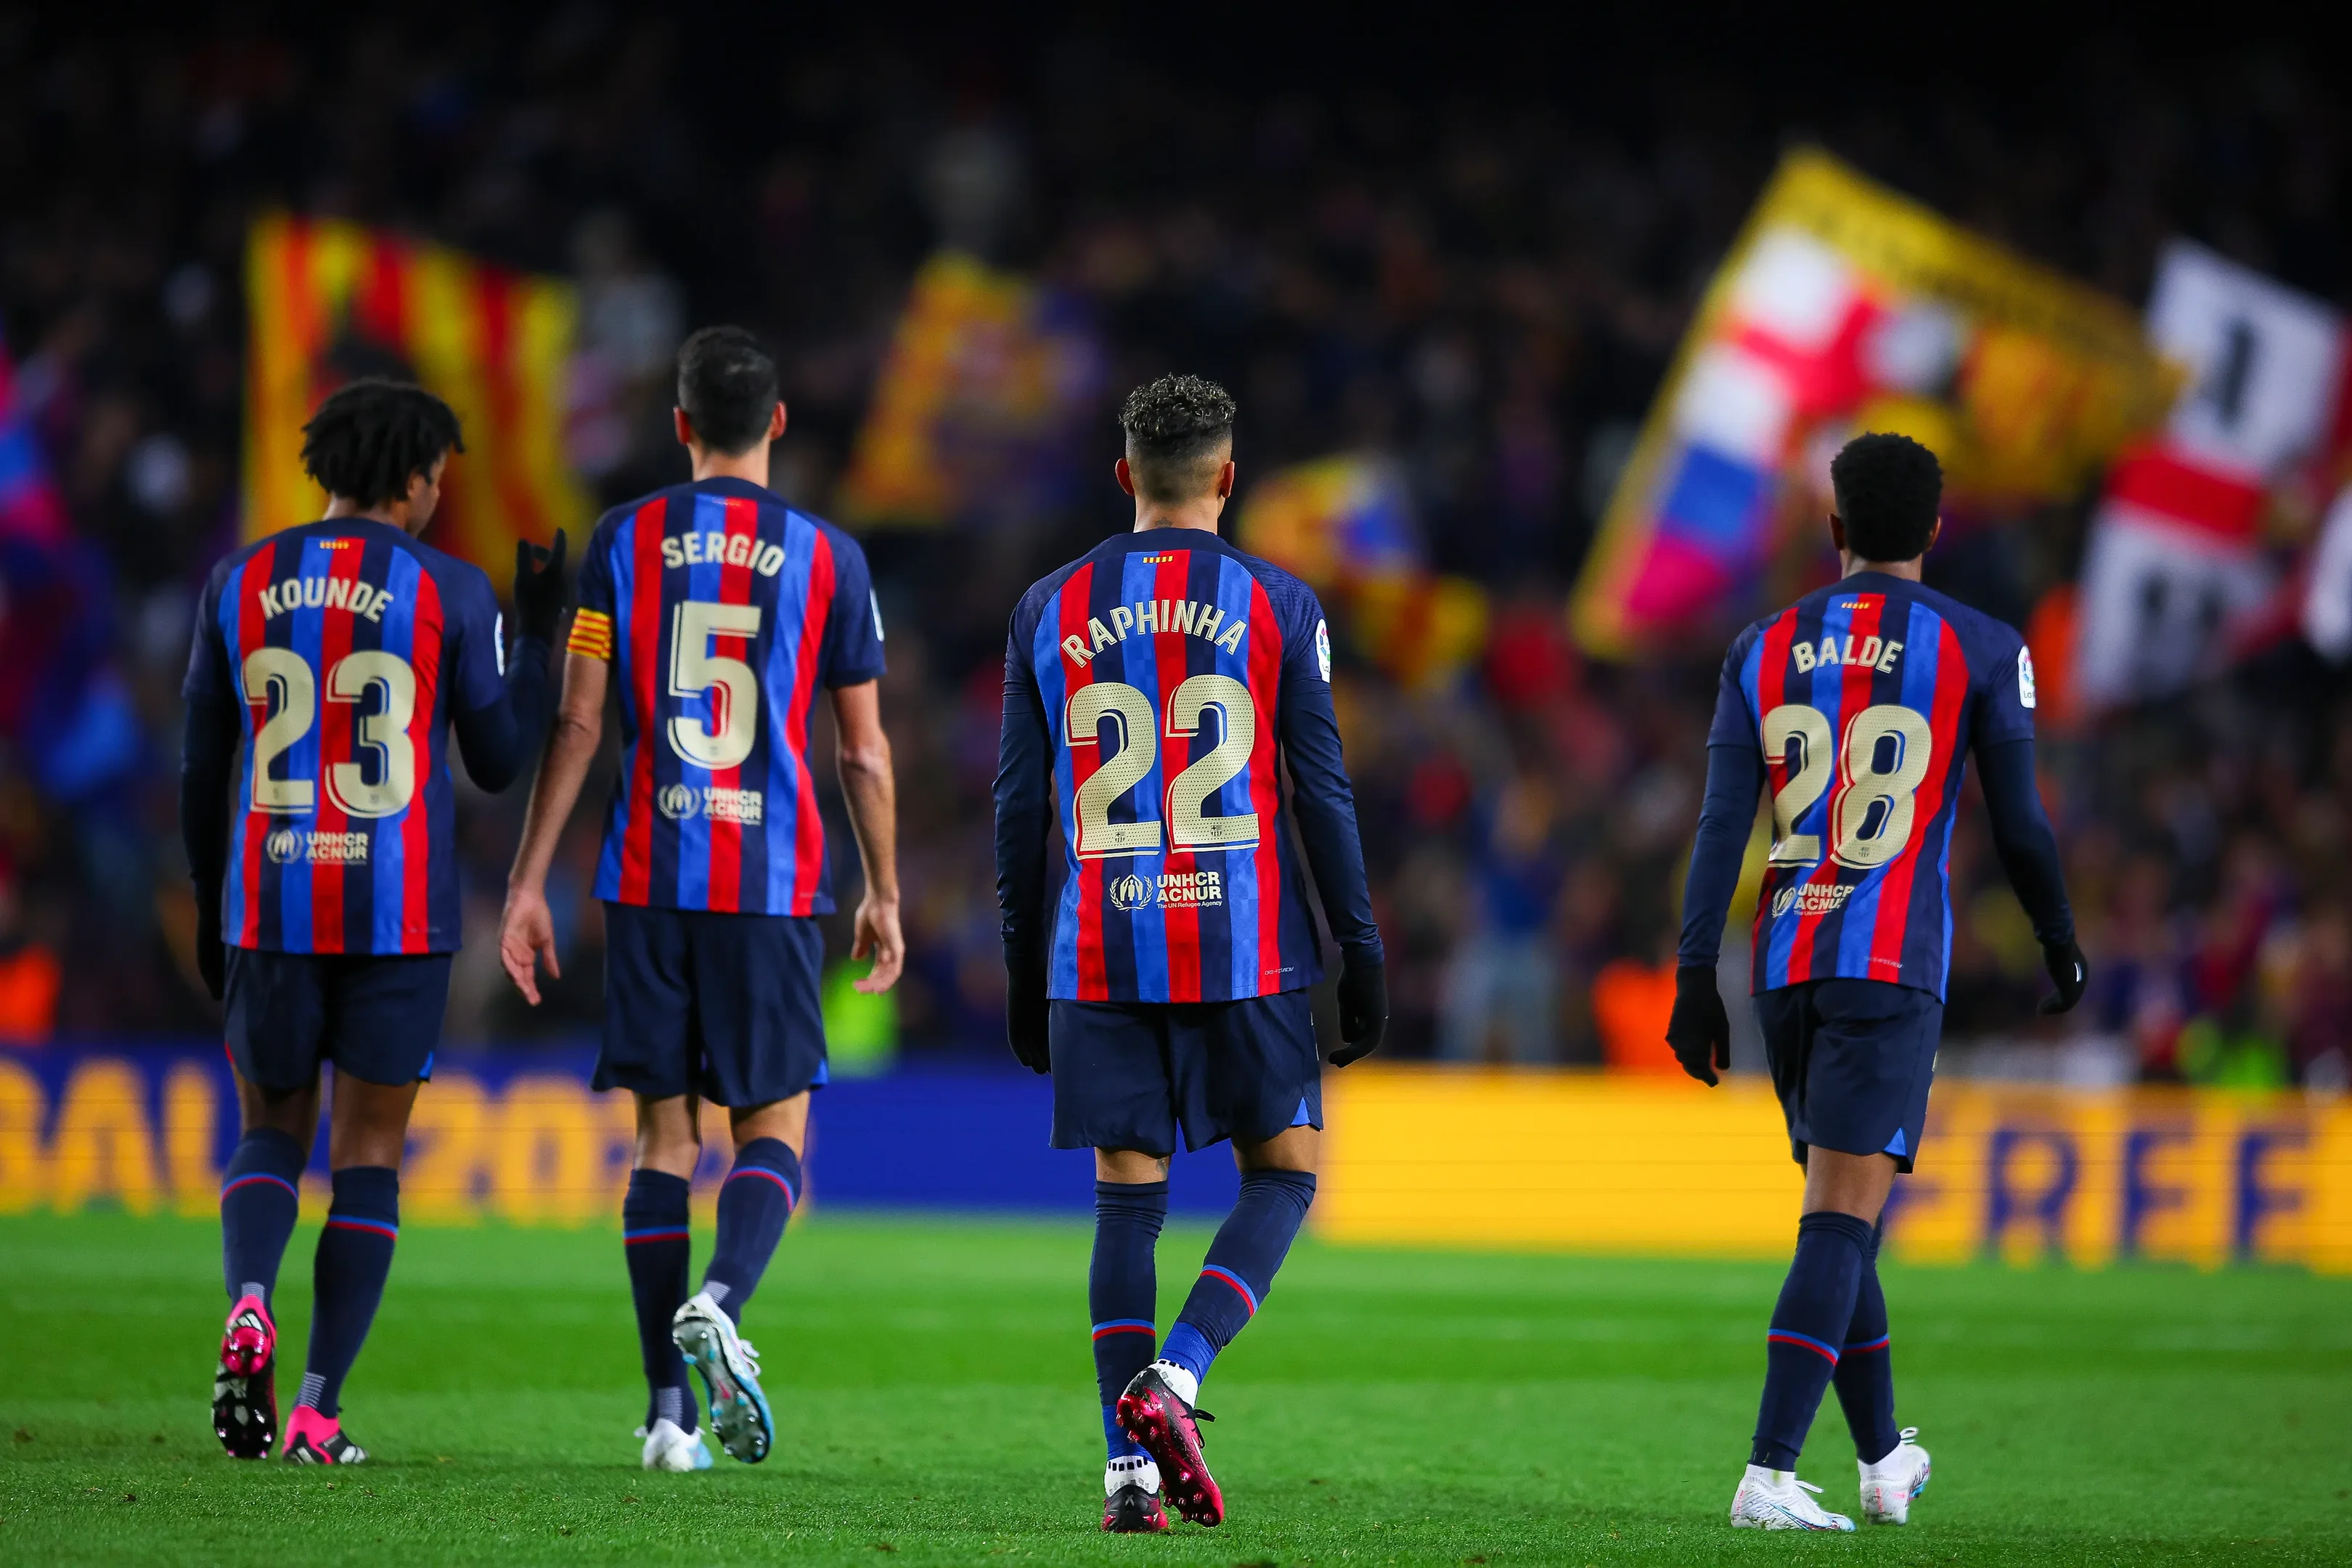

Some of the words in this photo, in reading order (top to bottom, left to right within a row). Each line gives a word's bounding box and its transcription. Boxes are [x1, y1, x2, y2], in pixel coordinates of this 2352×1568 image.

[661, 531, 785, 578] SERGIO
[258, 577, 394, 623] KOUNDE
[1061, 599, 1247, 669] RAPHINHA
[1792, 634, 1904, 675] BALDE
[667, 600, 762, 770] 5
[241, 647, 417, 818] 23
[1065, 674, 1261, 860] 22
[1760, 704, 1933, 869] 28
[305, 831, 369, 846] UNHCR
[305, 844, 368, 860] ACNUR
[1156, 871, 1221, 888] UNHCR
[1156, 886, 1223, 902] ACNUR
